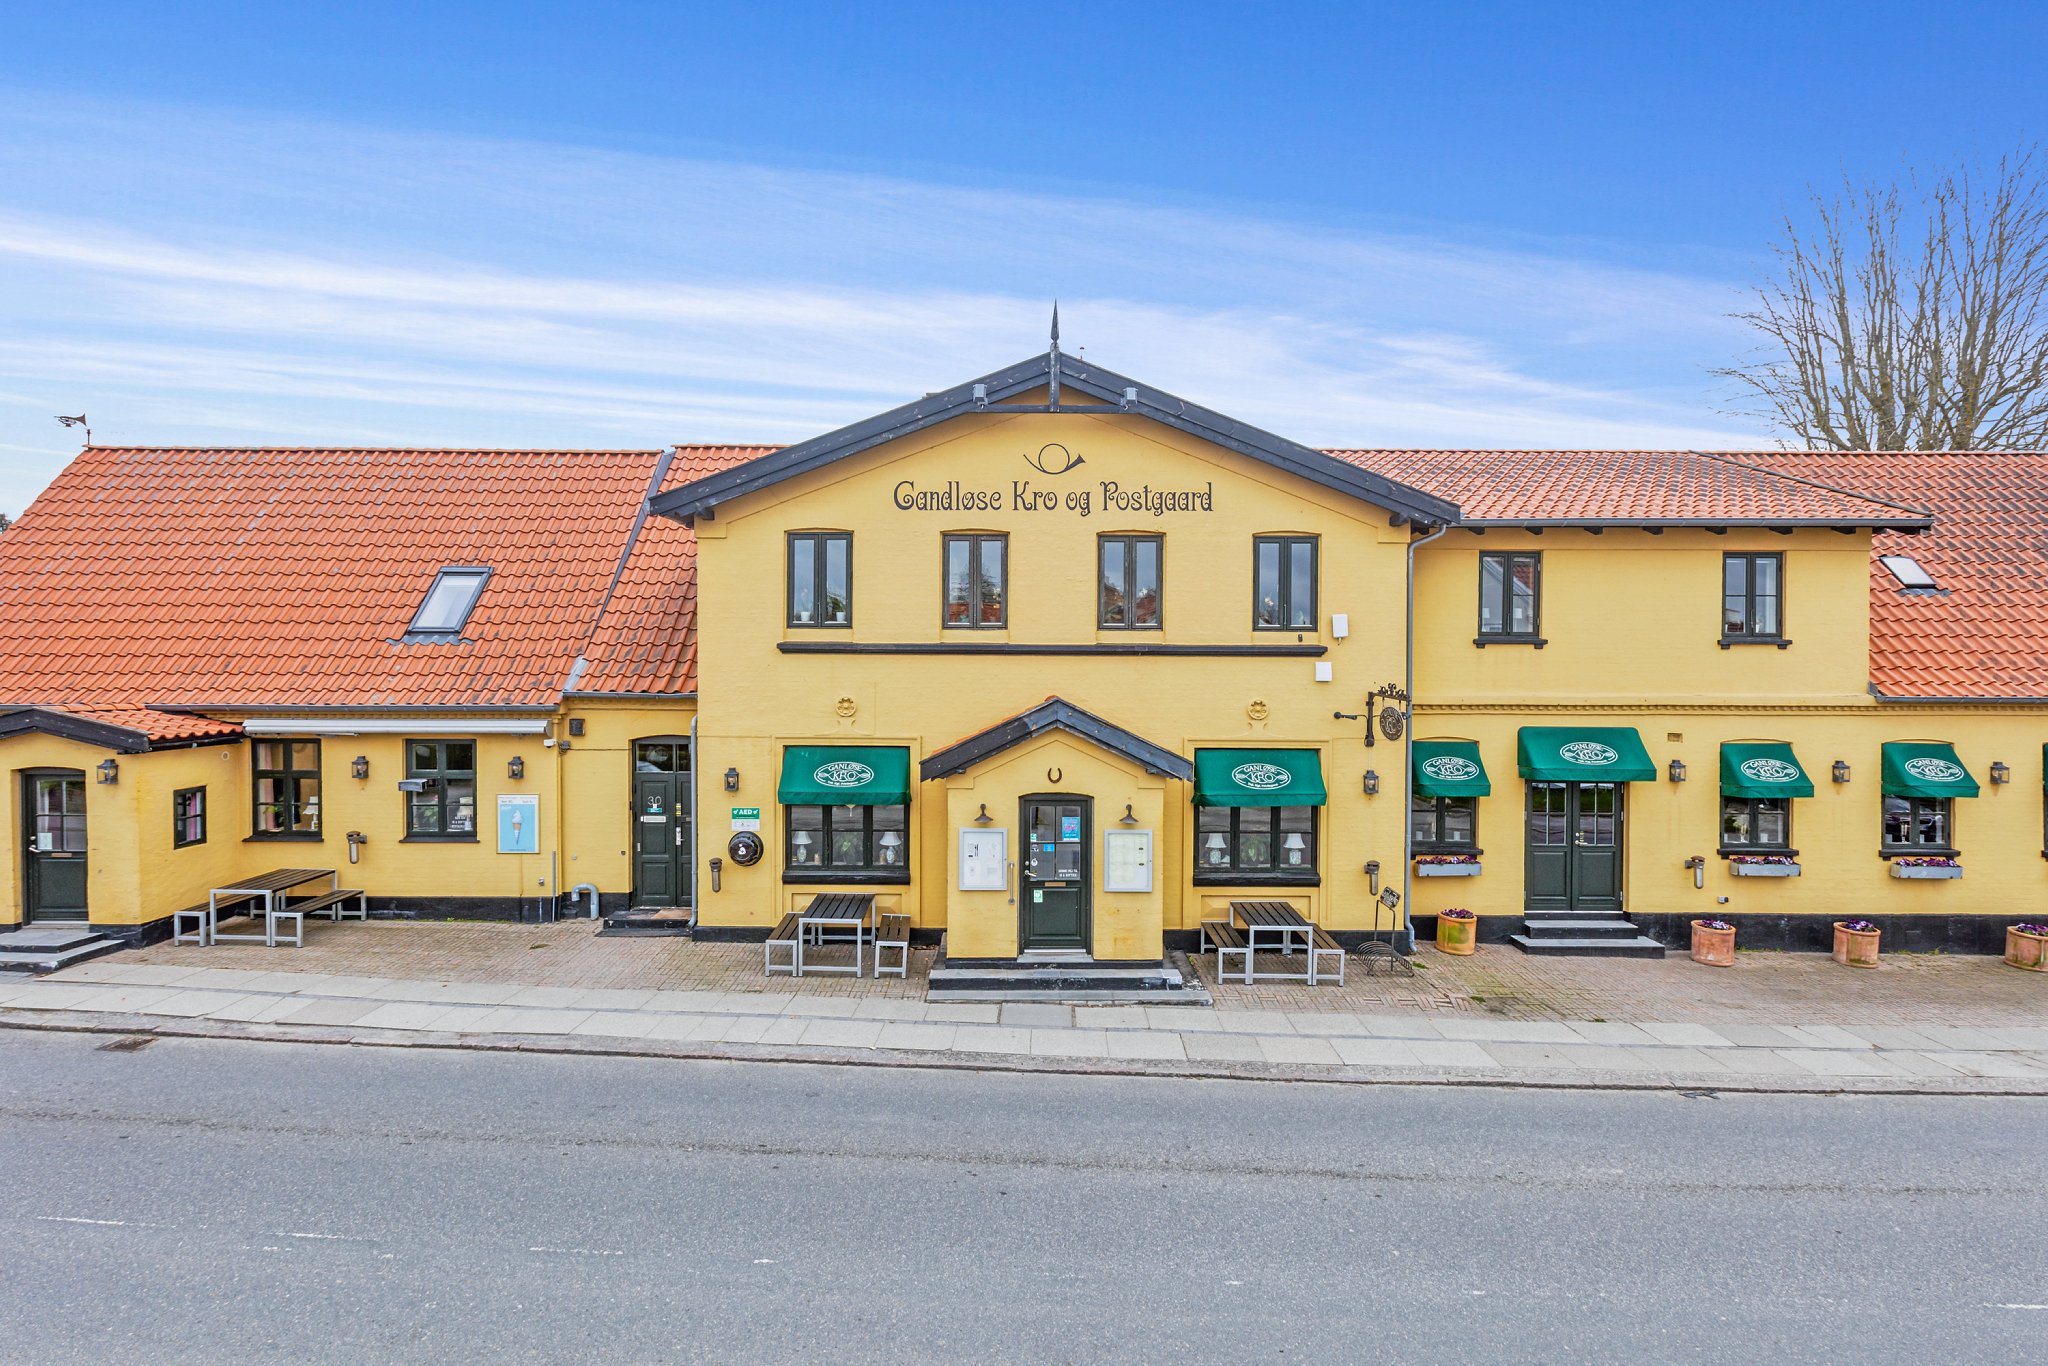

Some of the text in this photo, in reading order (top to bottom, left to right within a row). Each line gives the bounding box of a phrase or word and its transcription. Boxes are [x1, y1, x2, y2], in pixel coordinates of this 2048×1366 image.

[893, 480, 1214, 517] Gandløse Kro og Postgaard
[1577, 750, 1602, 760] KRO
[827, 763, 863, 772] GANLØSE
[1243, 765, 1278, 774] GANLØSE
[1440, 765, 1463, 775] KRO
[833, 771, 857, 782] KRO
[1250, 772, 1274, 783] KRO
[647, 796, 662, 805] 30
